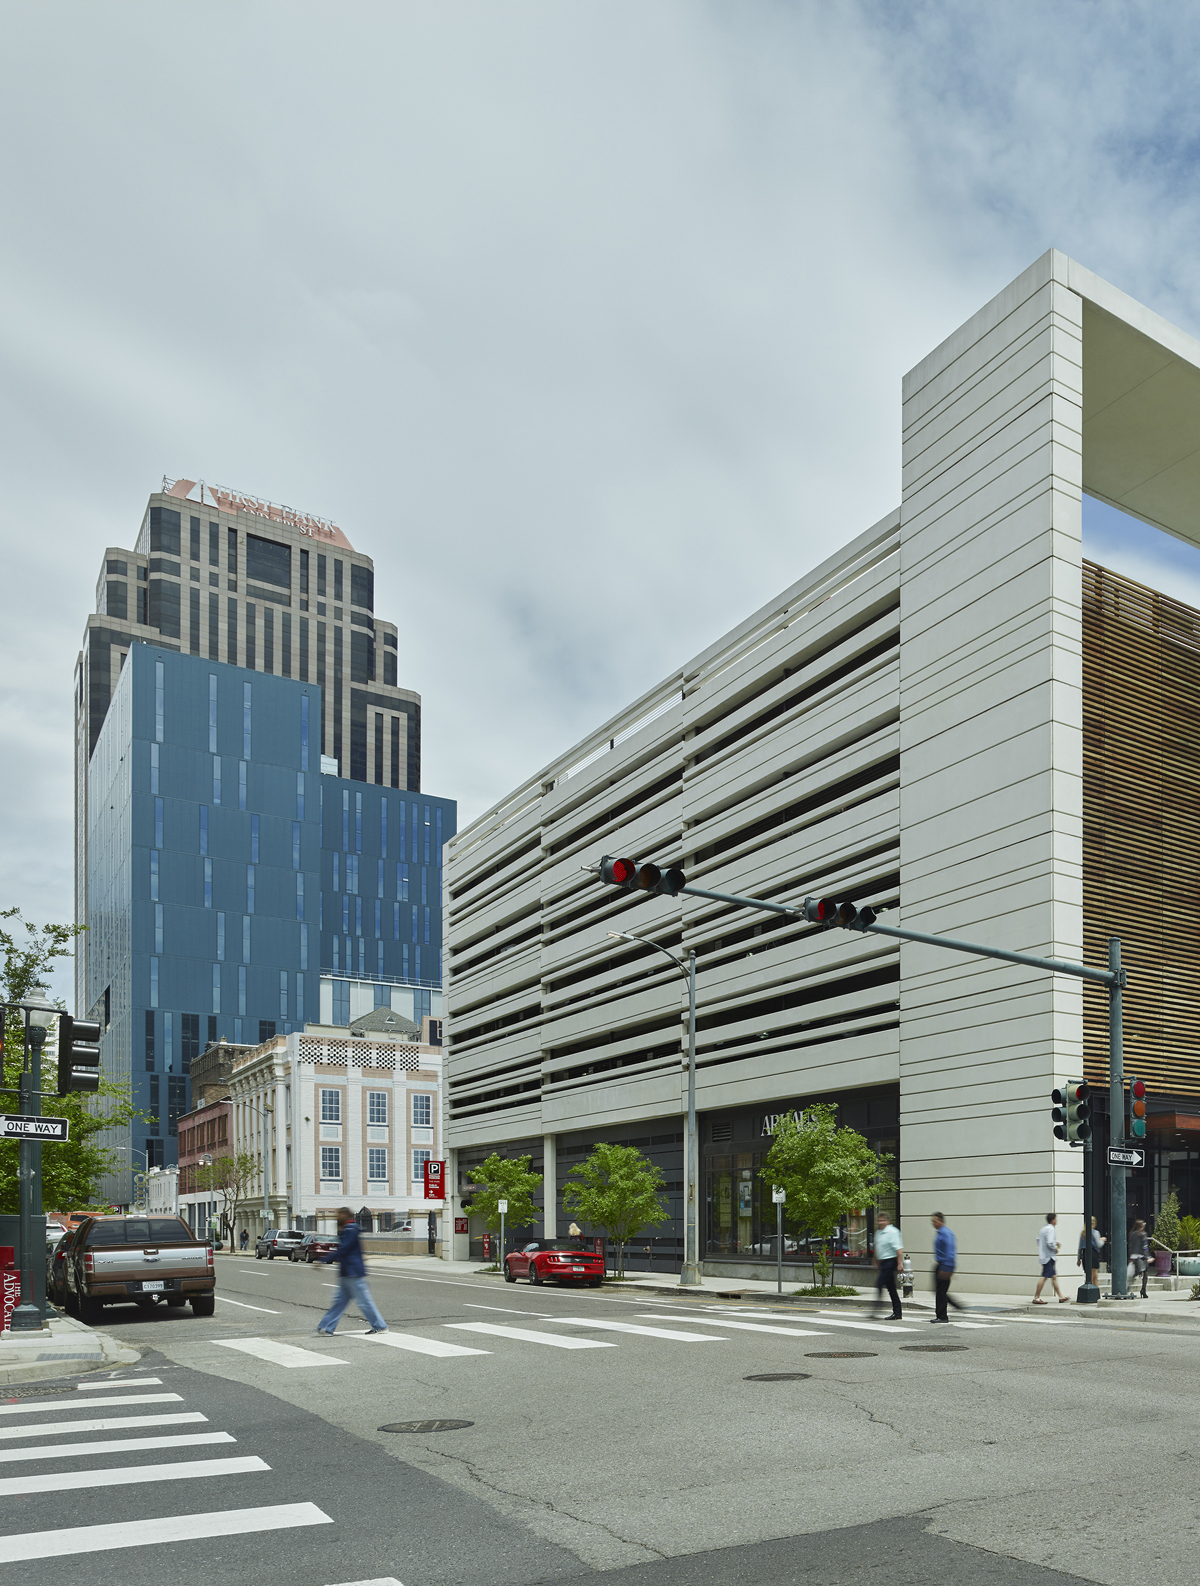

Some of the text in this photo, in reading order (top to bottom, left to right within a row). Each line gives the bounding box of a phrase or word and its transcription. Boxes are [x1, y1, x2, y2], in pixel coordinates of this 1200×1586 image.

[216, 484, 271, 513] FIRST
[281, 504, 336, 534] BANK
[7, 1122, 58, 1134] ONE WAY
[1111, 1152, 1121, 1160] ONE
